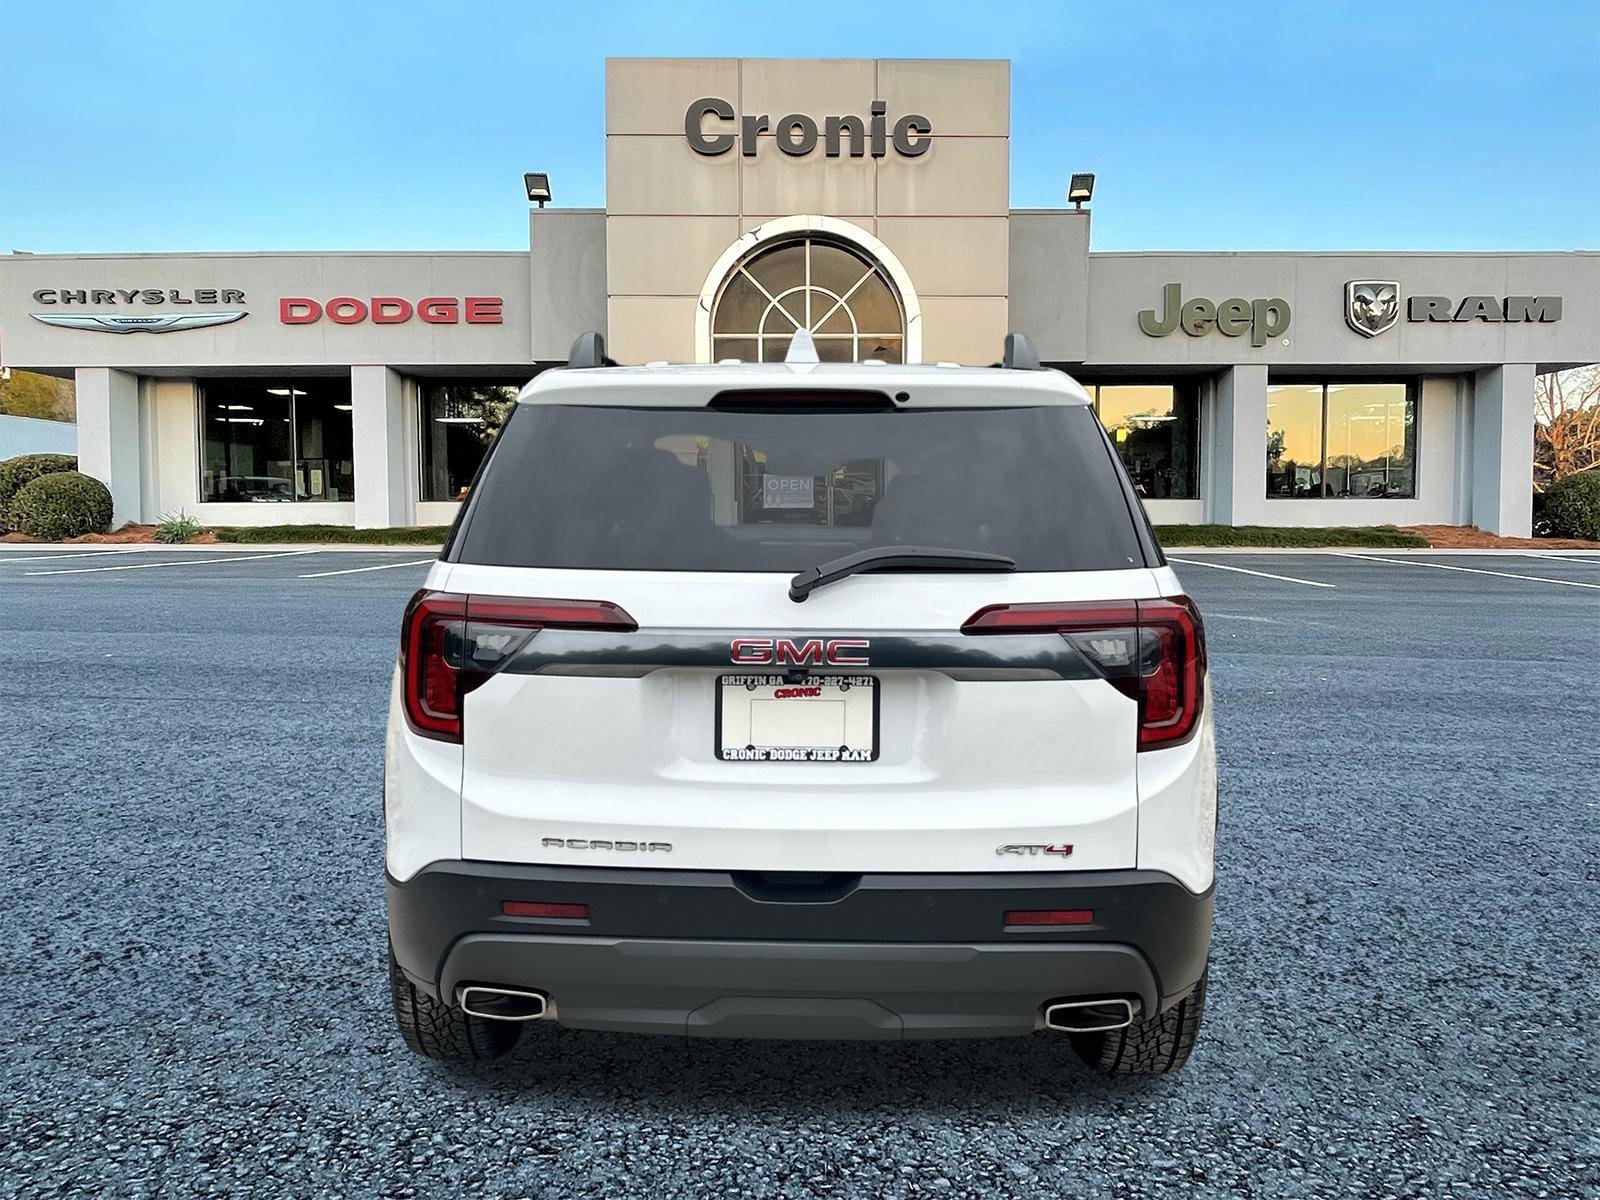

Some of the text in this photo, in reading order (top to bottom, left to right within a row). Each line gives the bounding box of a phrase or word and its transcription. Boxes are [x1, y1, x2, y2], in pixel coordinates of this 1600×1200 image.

[685, 97, 932, 157] Cronic
[32, 288, 246, 304] CHRYSLER
[280, 297, 503, 325] DODGE
[1138, 283, 1291, 347] Jeep
[1407, 296, 1563, 323] RAM
[767, 479, 810, 490] OPEN
[730, 639, 870, 666] GMC
[722, 675, 767, 685] GRIFFIN
[769, 676, 784, 685] GA
[774, 687, 822, 699] CRONIC
[723, 750, 872, 761] CRONIC DODGE JEEP RAM
[541, 838, 673, 852] ACADIA
[996, 843, 1074, 858] AT4
